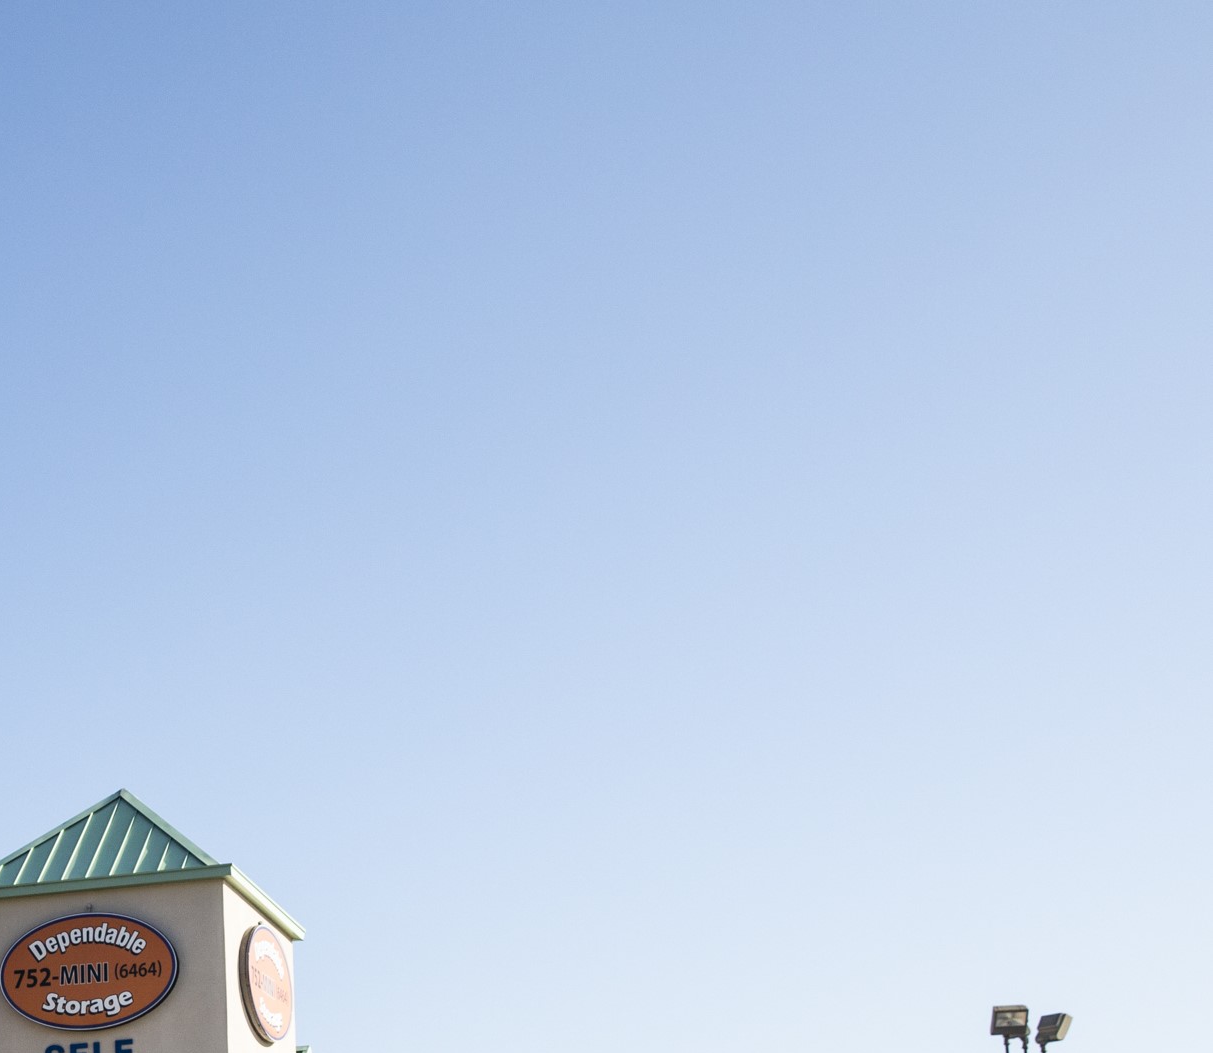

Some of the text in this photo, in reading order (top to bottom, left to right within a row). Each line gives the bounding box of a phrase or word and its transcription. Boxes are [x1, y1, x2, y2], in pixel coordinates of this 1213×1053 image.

[28, 923, 147, 962] Dependable
[14, 960, 162, 989] 752-MINI (6464)
[42, 990, 134, 1016] Storage
